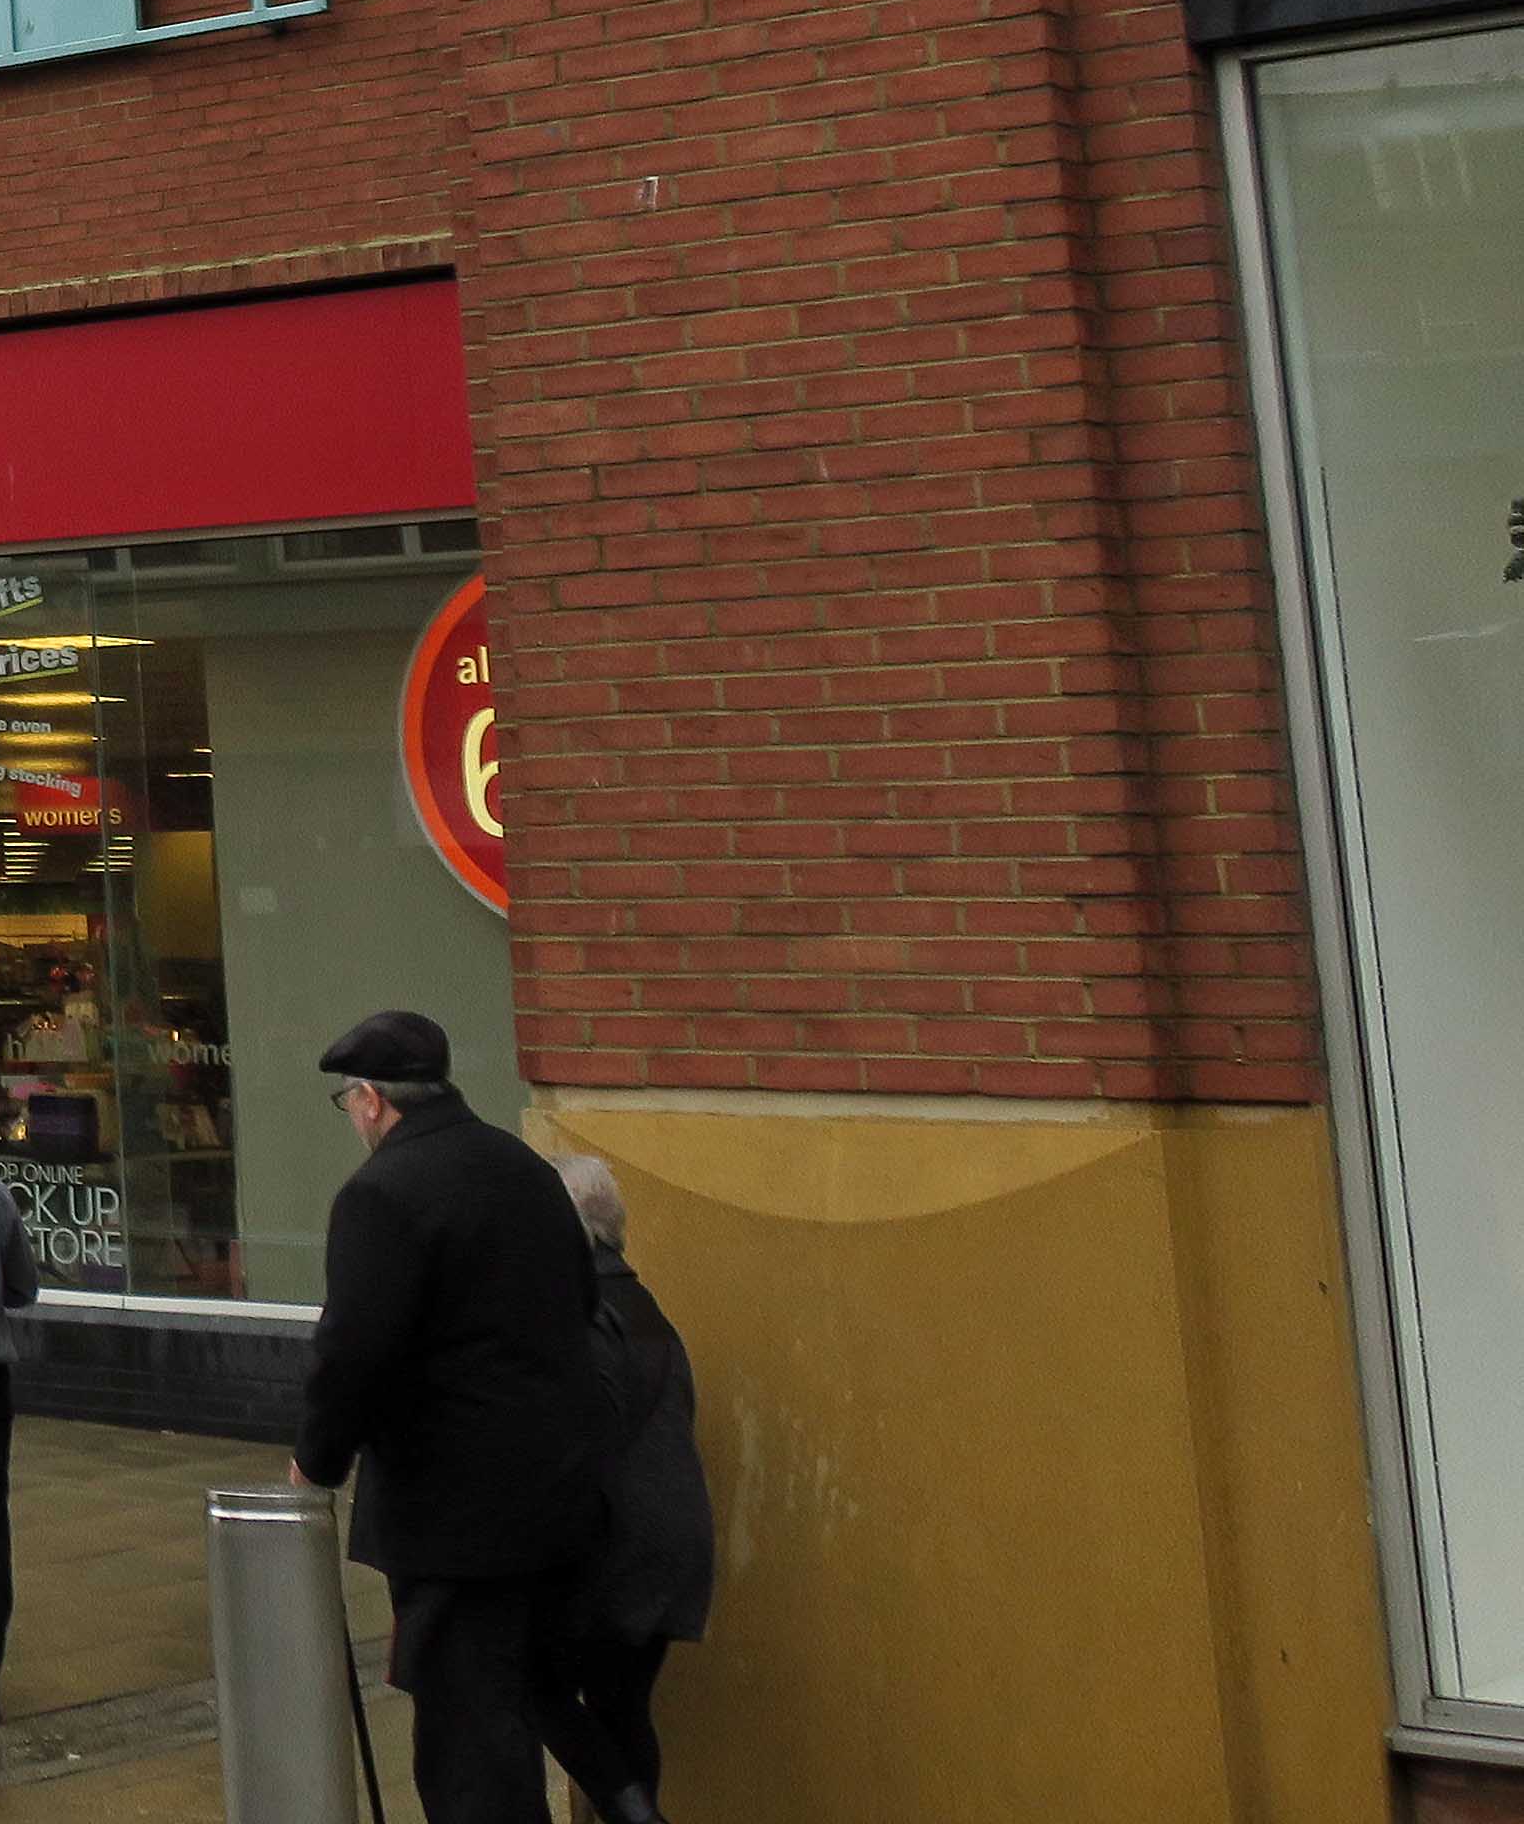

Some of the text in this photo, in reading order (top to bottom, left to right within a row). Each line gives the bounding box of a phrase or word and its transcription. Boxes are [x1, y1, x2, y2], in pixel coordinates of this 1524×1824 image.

[11, 720, 52, 732] even
[22, 1163, 84, 1185] ONLINE
[7, 1182, 120, 1226] CK UP
[24, 1224, 123, 1268] TORE
